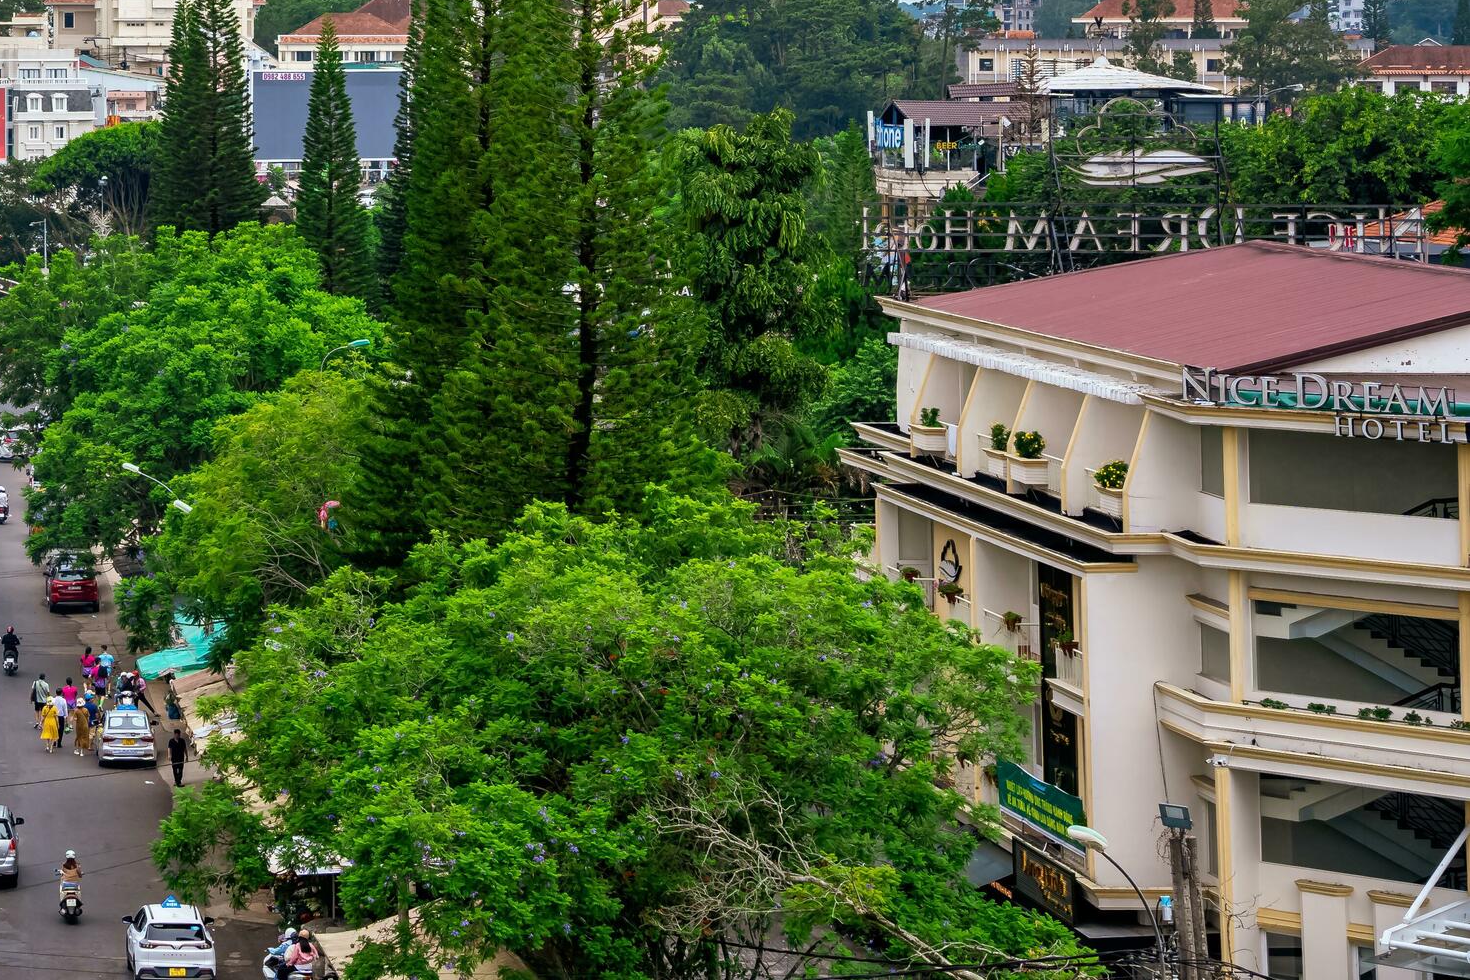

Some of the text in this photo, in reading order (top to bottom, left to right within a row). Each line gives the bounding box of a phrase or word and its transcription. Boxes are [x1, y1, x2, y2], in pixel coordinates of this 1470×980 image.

[936, 141, 957, 150] BEER
[1181, 366, 1455, 418] NICE DREAM
[1334, 416, 1455, 445] HOTEL
